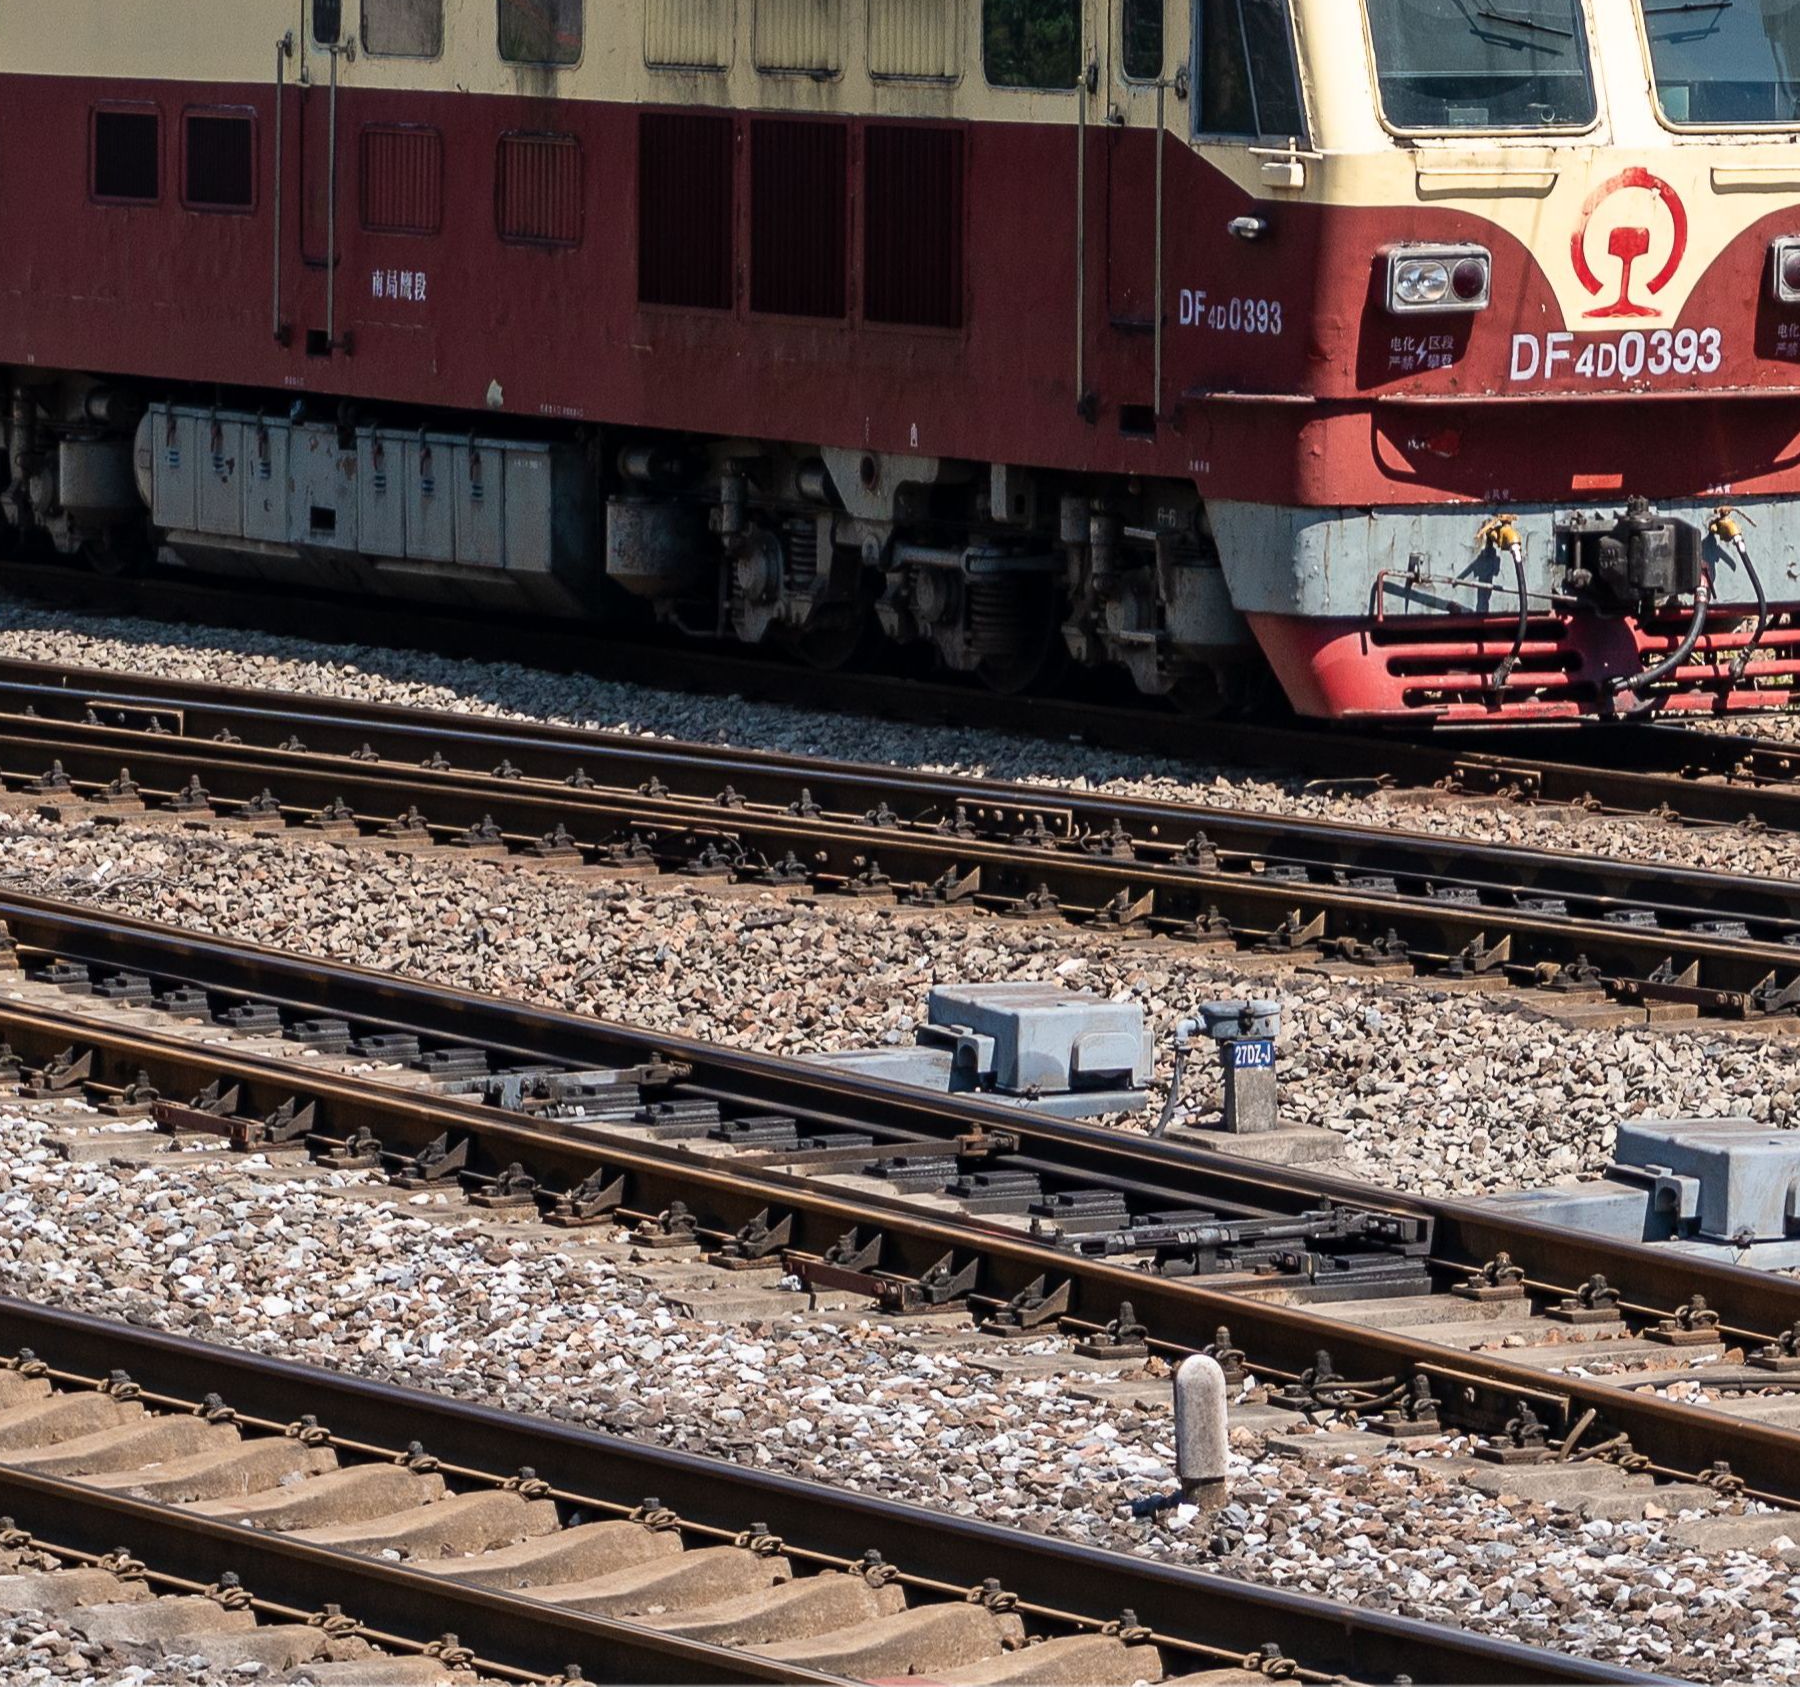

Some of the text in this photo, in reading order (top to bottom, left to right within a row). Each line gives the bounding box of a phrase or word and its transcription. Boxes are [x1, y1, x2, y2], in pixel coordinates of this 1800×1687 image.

[1179, 288, 1283, 335] DF4D0393
[1390, 335, 1454, 352] 电化 区段
[1510, 327, 1722, 381] DF4D0393
[1235, 1044, 1271, 1065] 27DZ-J
